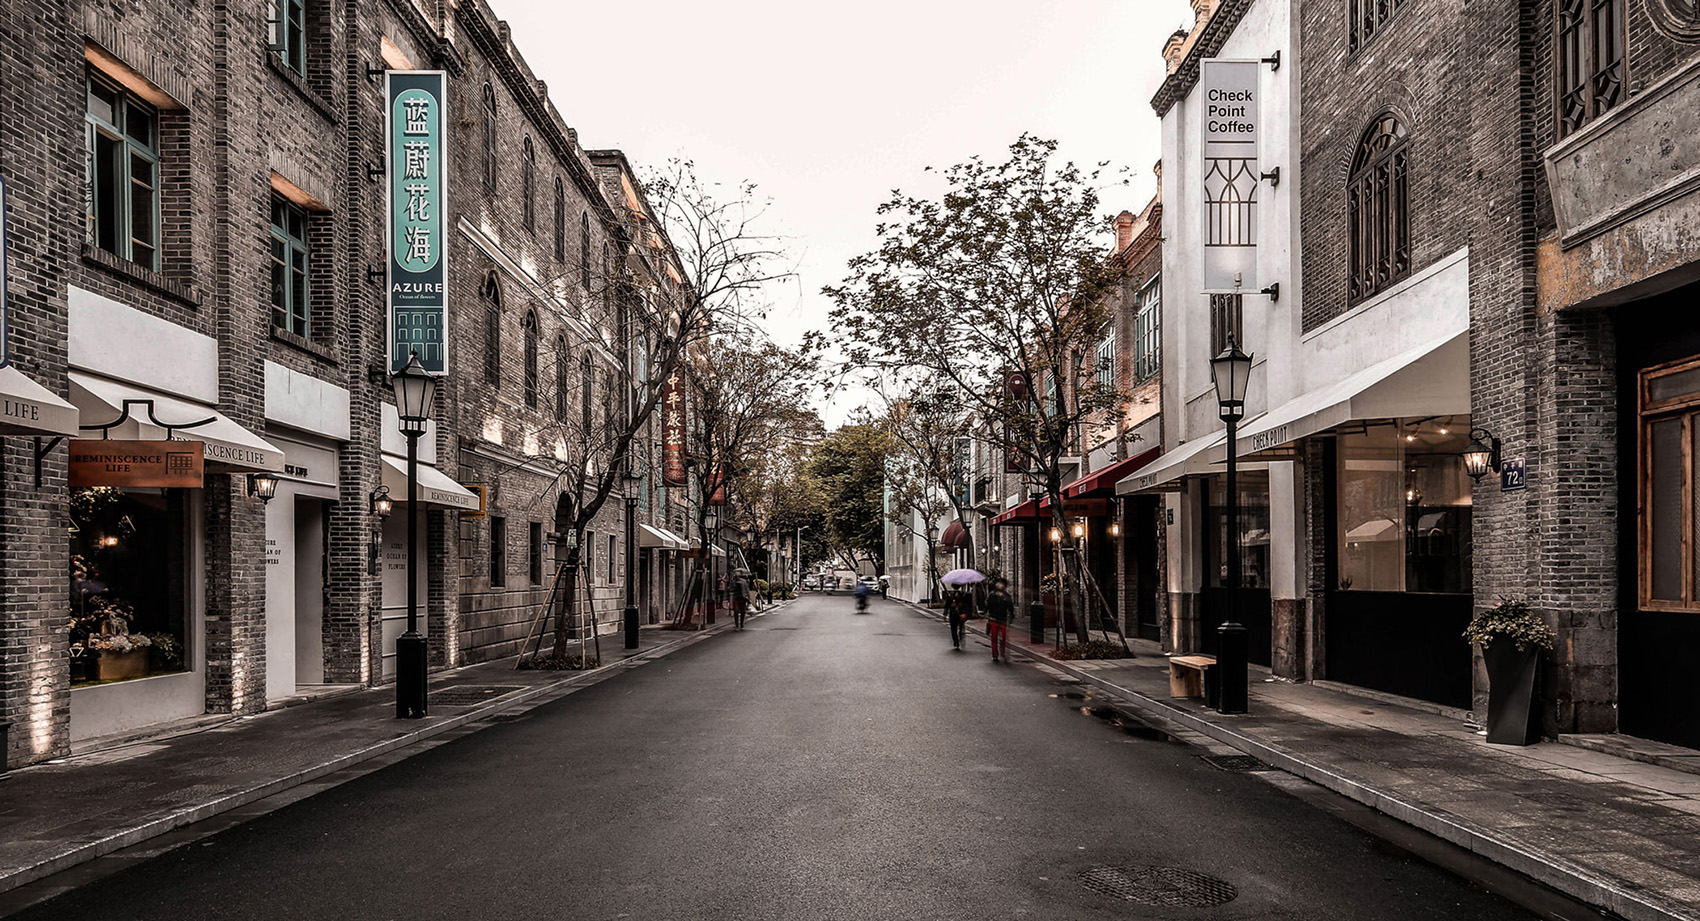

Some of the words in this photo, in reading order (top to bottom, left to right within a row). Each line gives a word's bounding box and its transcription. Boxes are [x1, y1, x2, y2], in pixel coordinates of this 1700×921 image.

[1208, 89, 1253, 101] Check
[1208, 105, 1245, 117] Point
[1208, 120, 1254, 133] Coffee
[402, 97, 430, 264] 蓝蔚花海
[392, 282, 443, 293] AZURE
[4, 400, 40, 421] LIFE
[1253, 433, 1270, 451] CHECK
[1270, 426, 1288, 446] POINT
[75, 455, 163, 464] REMINISCENCE
[246, 450, 265, 465] LIFE
[106, 464, 131, 473] LIFE
